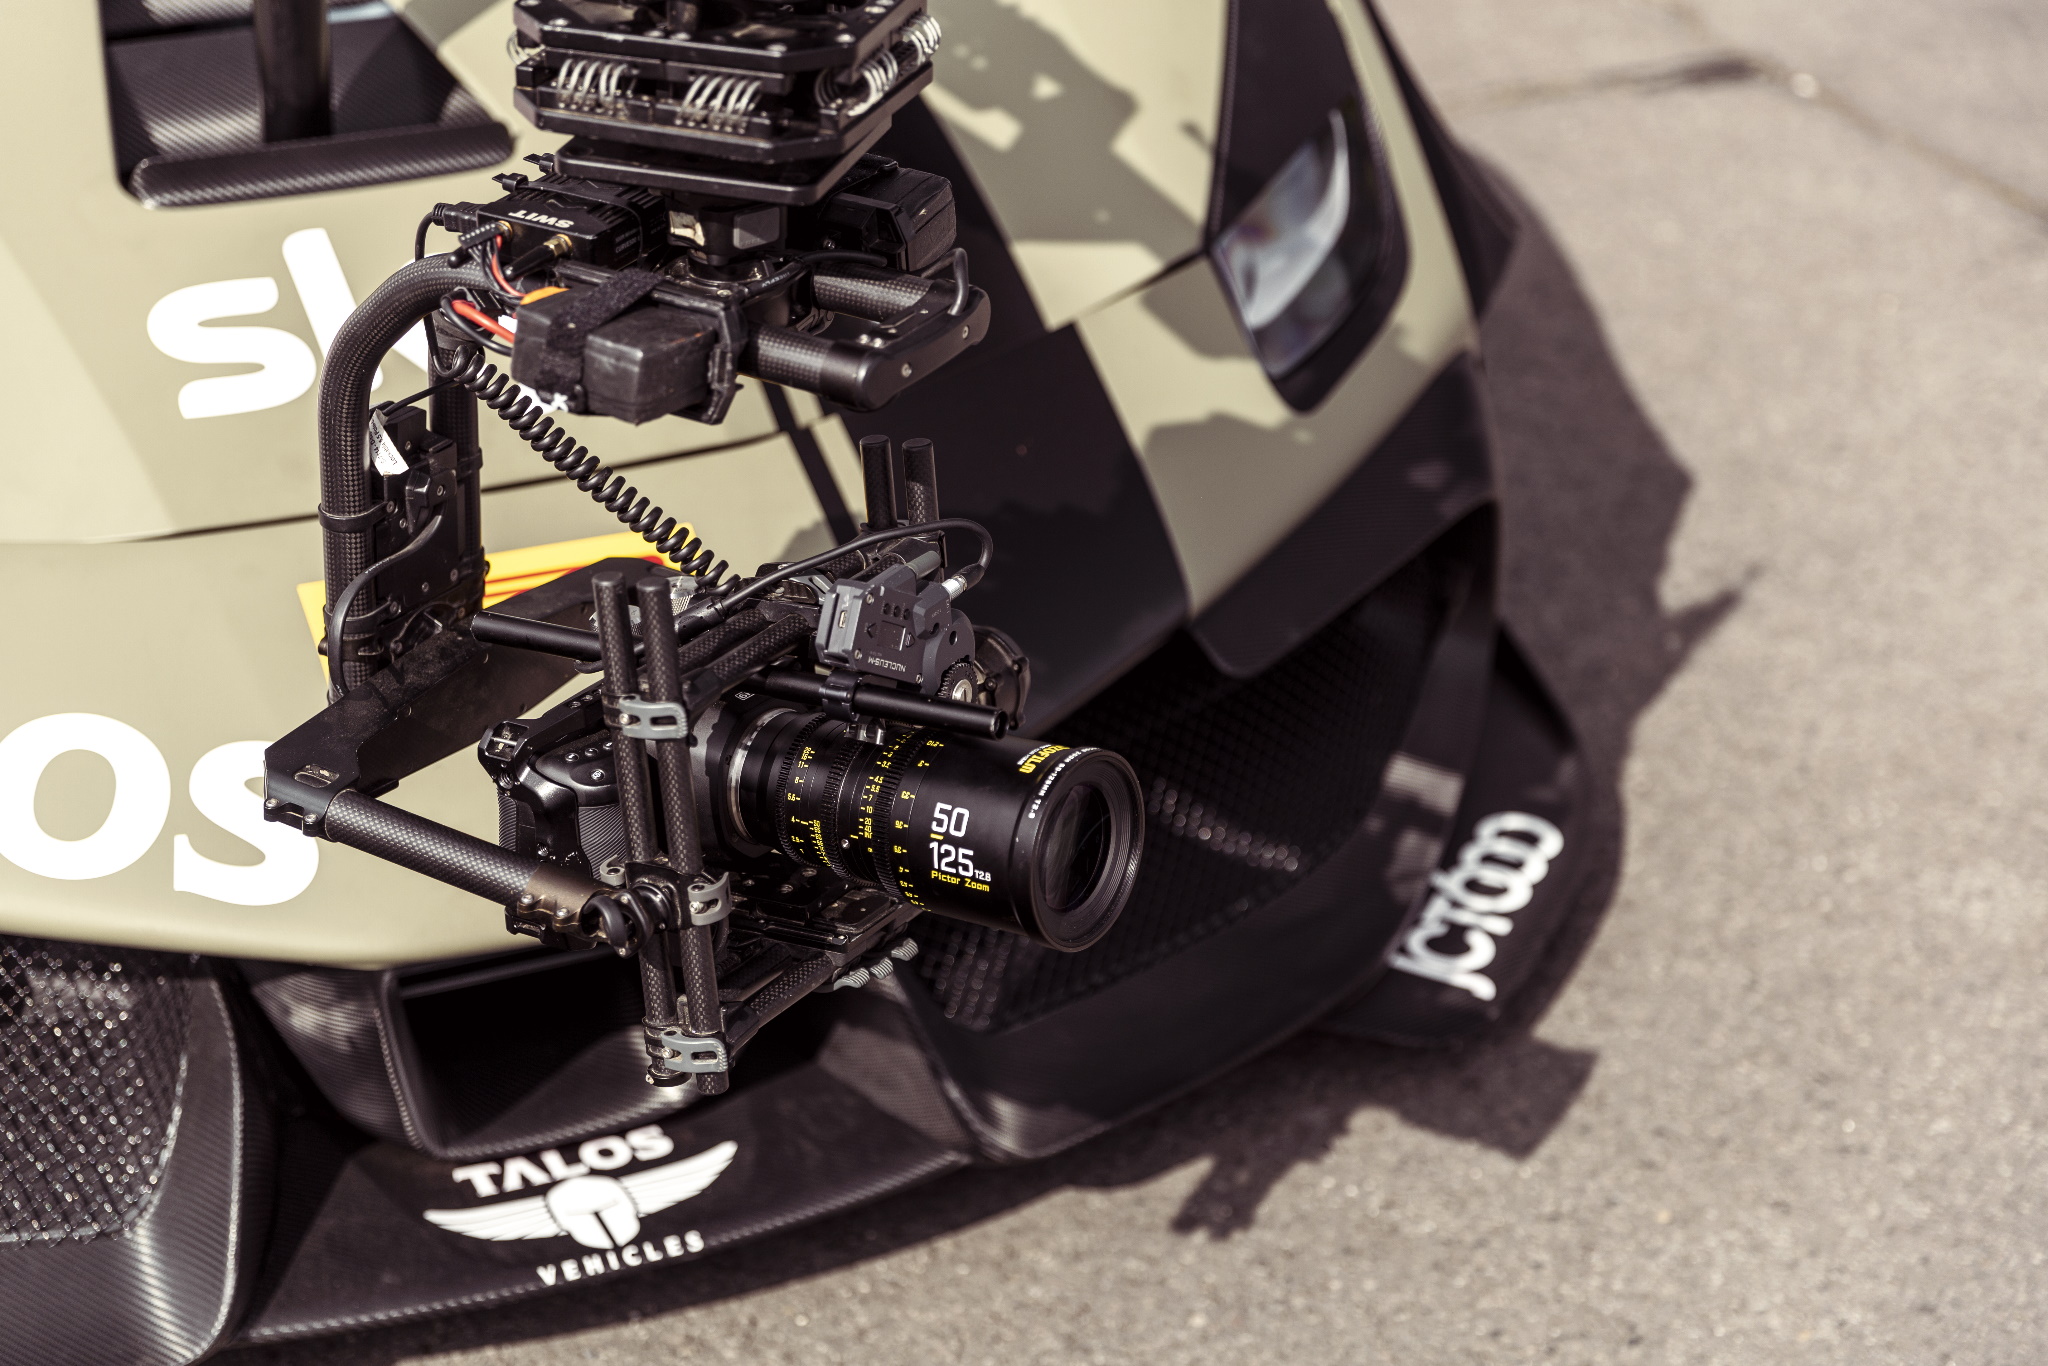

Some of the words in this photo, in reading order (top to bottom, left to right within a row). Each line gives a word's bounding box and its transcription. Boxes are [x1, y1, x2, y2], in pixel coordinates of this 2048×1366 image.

[507, 209, 575, 229] SWIT
[867, 656, 907, 673] NUCLEUS-M
[931, 802, 970, 838] 50
[929, 841, 974, 877] 125
[974, 869, 992, 882] T2.8
[931, 870, 961, 885] Pictor
[964, 878, 990, 892] Zoom
[451, 1123, 676, 1199] TALOS
[536, 1229, 705, 1286] VEHICLES
